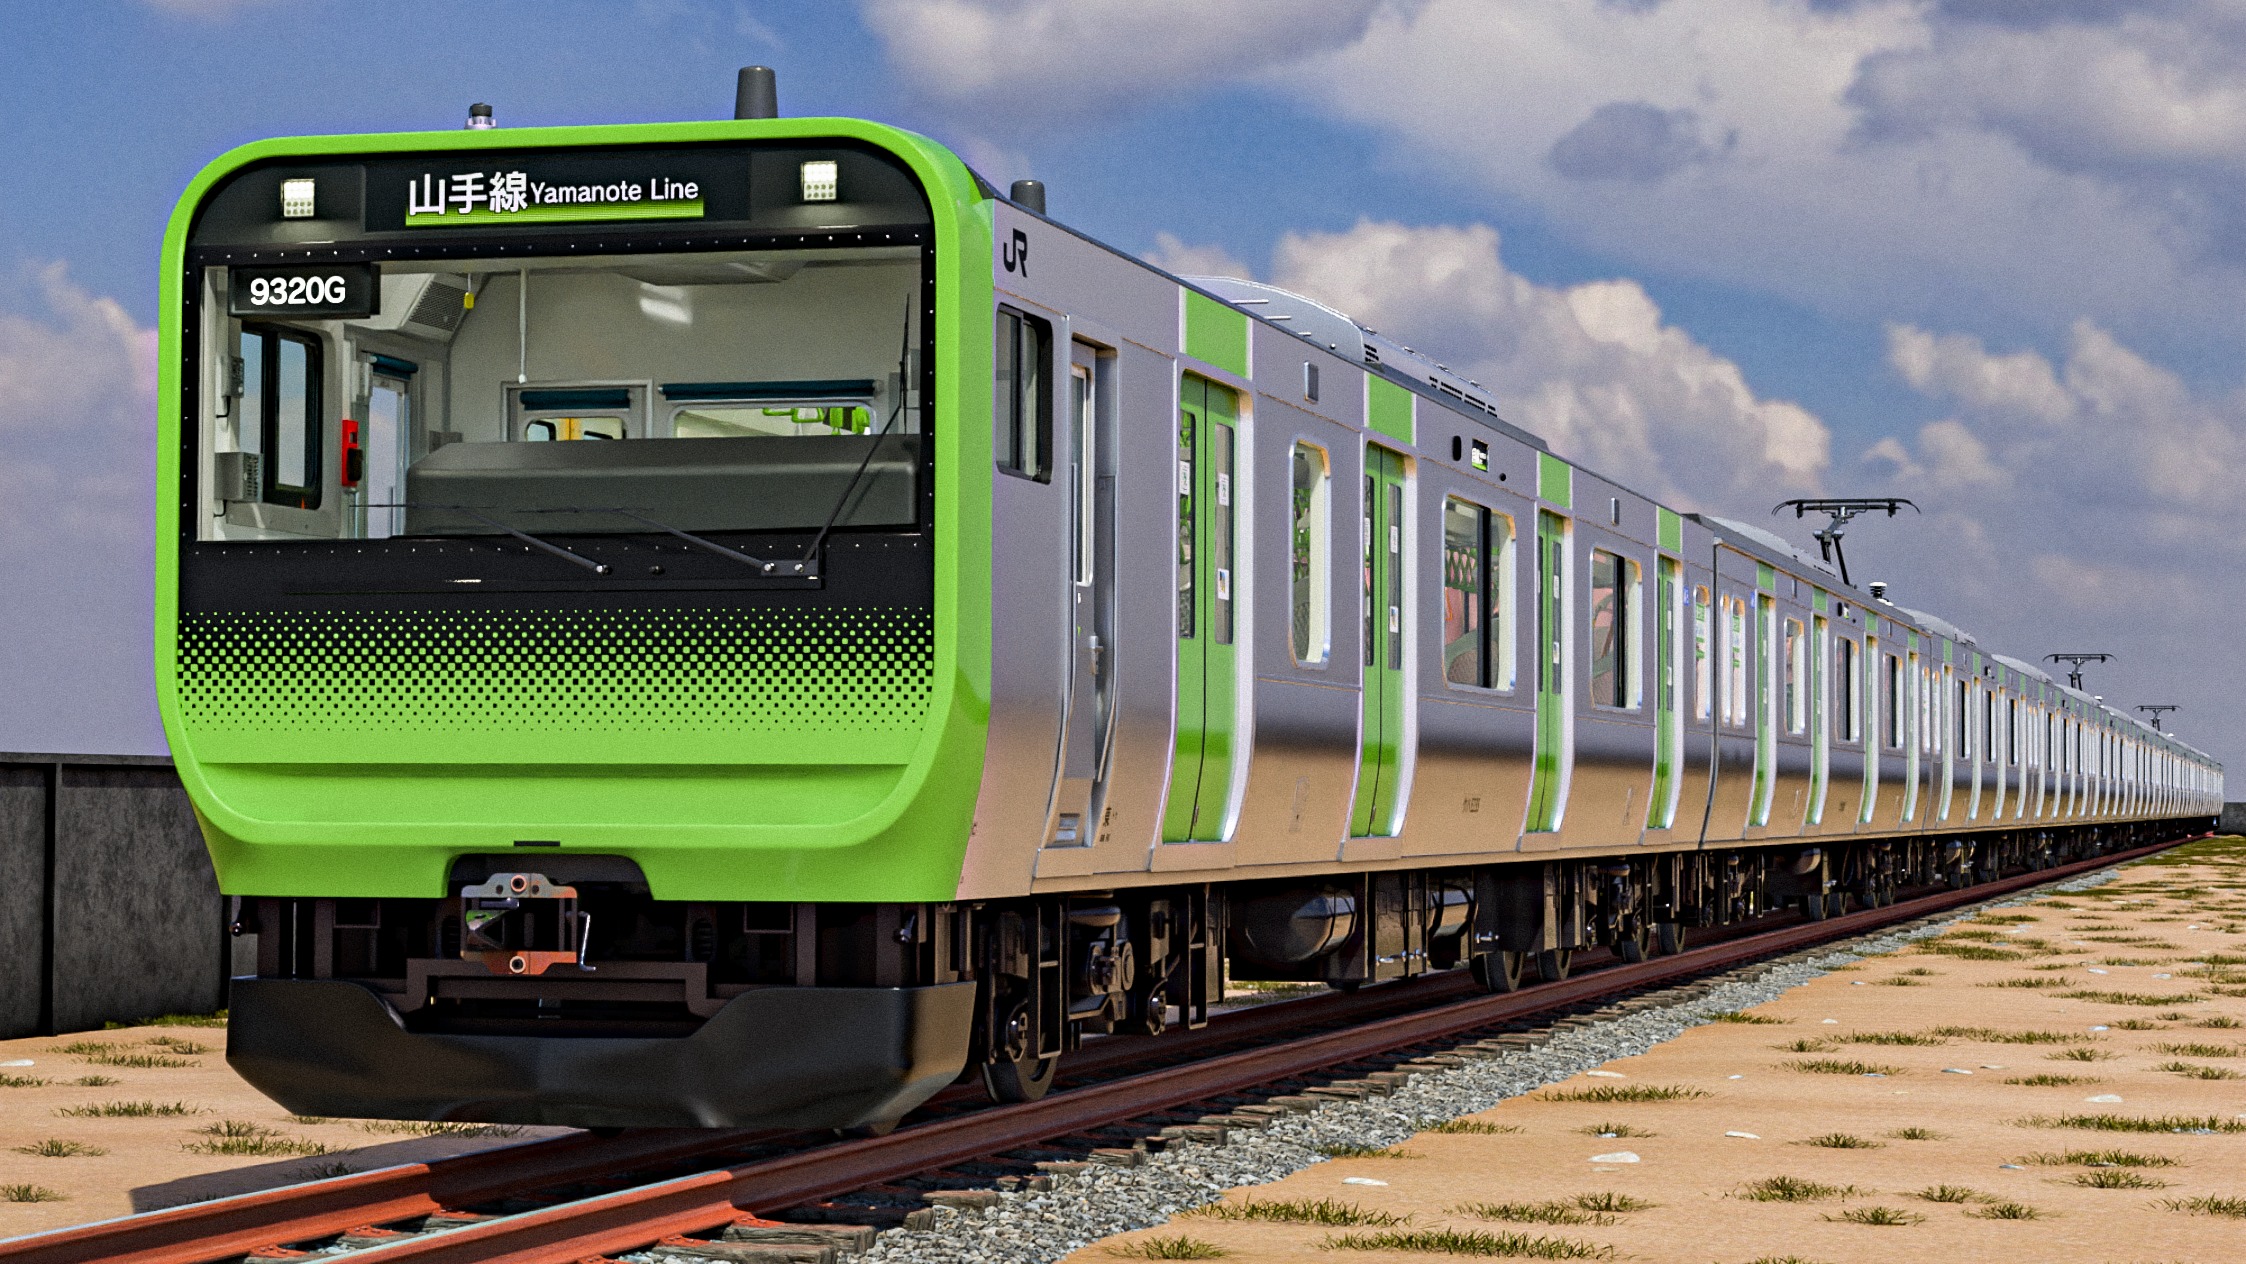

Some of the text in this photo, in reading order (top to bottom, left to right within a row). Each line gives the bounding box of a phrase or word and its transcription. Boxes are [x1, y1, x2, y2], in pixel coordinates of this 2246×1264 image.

[409, 171, 699, 216] 山手線 Yamanote Line
[1003, 227, 1028, 278] JR
[250, 275, 346, 306] 9320G
